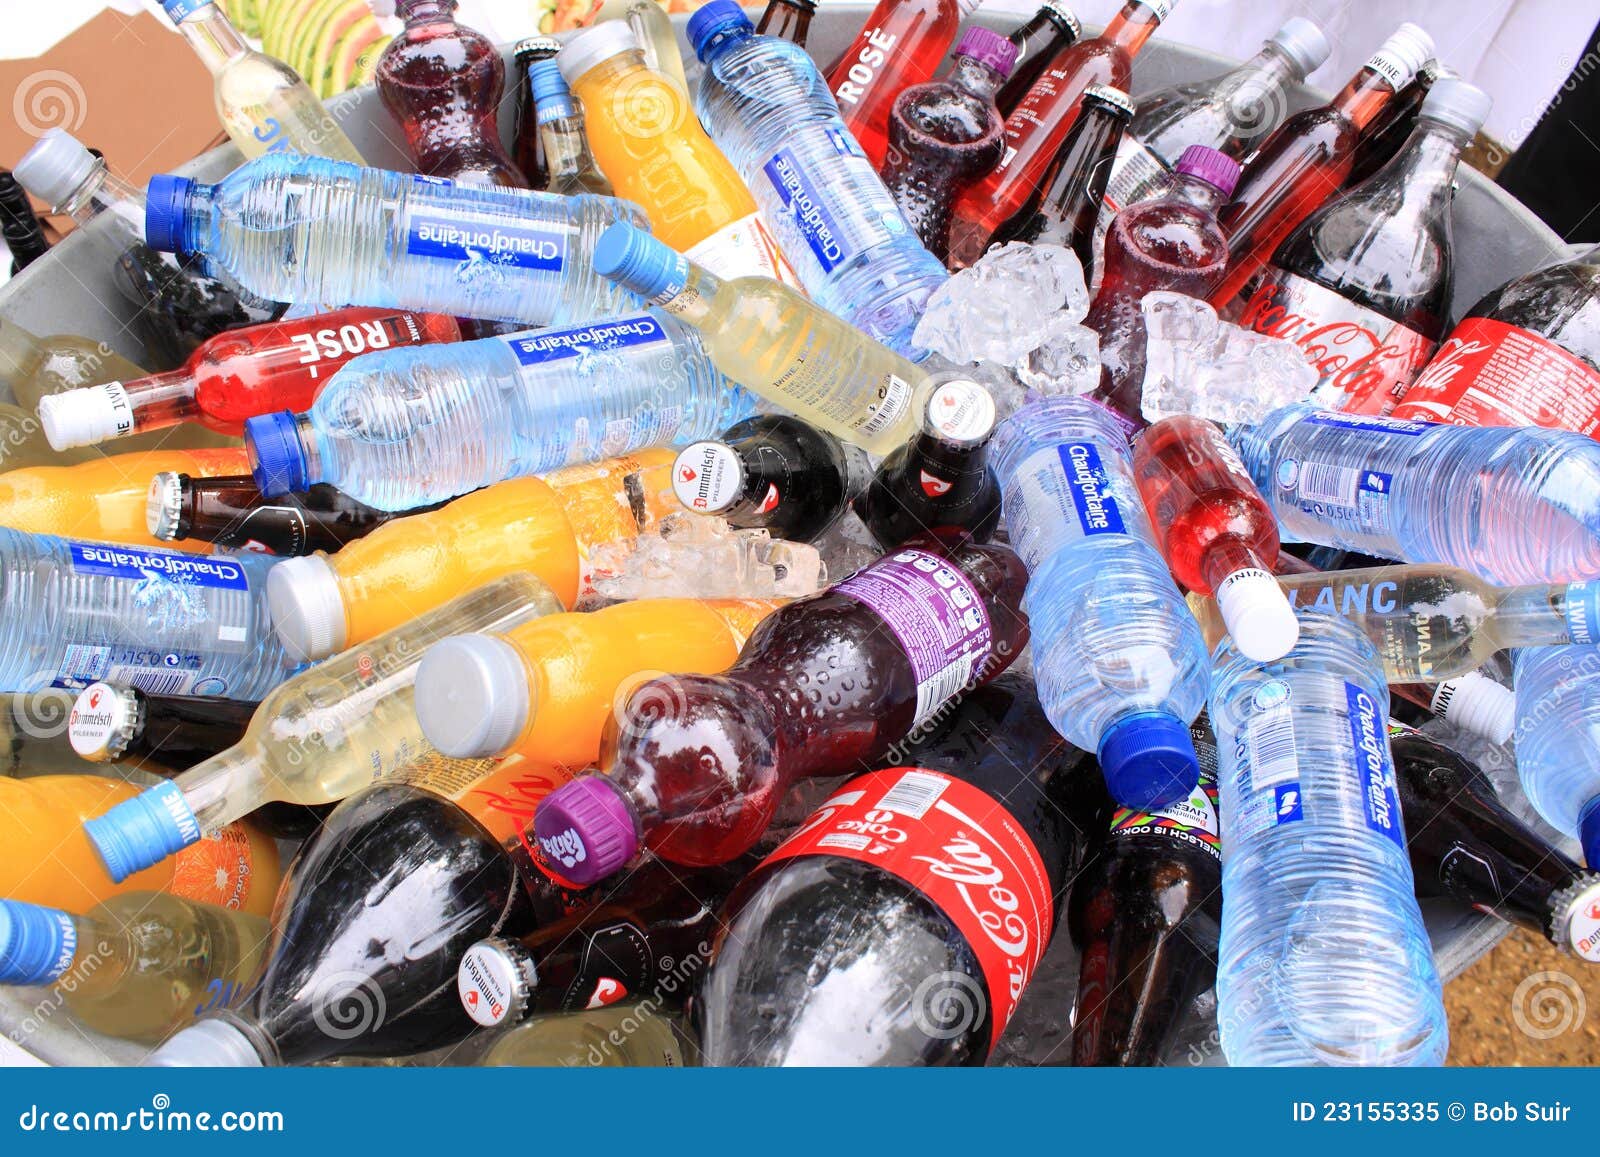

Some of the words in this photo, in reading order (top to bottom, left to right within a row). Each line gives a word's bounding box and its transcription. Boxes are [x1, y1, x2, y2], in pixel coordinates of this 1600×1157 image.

[836, 27, 896, 104] ROSÉ
[775, 157, 841, 262] Chaudfontaine
[418, 224, 558, 261] Chaudfontaine
[290, 320, 390, 379] ROSÉ
[521, 320, 656, 354] Chaudfontaine
[693, 446, 718, 509] Dommelsch
[713, 458, 726, 503] PILSENER
[1068, 445, 1109, 529] Chaudfontaine
[83, 548, 239, 581] Chaudfontaine
[1288, 581, 1398, 615] LANC
[71, 710, 113, 728] Dommelsch
[1434, 683, 1457, 719] 1WIN
[1356, 692, 1392, 829] Chaudfontaine
[162, 789, 200, 843] 1WINE
[836, 820, 908, 844] Coke
[1153, 826, 1167, 836] IS
[539, 828, 587, 862] Fanta
[1170, 826, 1222, 860] MELSCH
[226, 855, 249, 909] Orange
[464, 953, 504, 1020] Dommelsch
